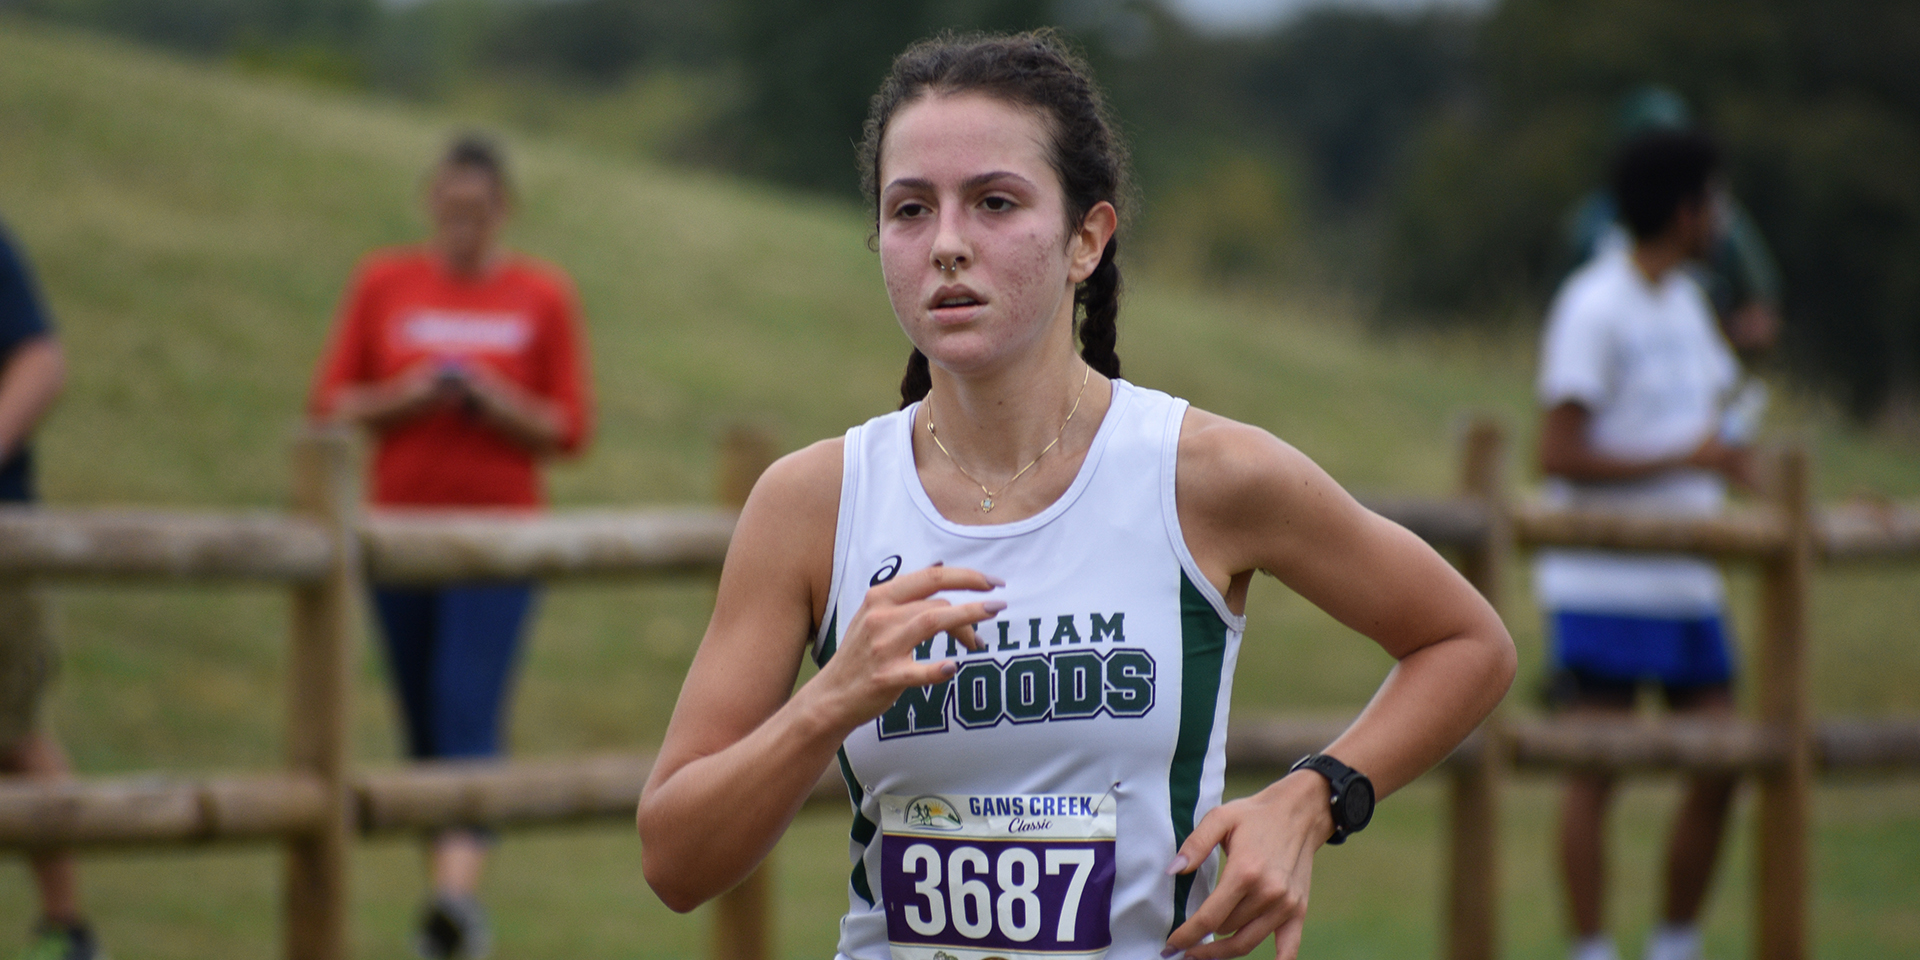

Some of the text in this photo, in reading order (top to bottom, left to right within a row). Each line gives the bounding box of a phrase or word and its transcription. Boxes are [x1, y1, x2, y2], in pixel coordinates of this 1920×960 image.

[969, 796, 1092, 816] GANS CREEK
[1008, 817, 1053, 833] Classic
[902, 843, 1095, 942] 3687
